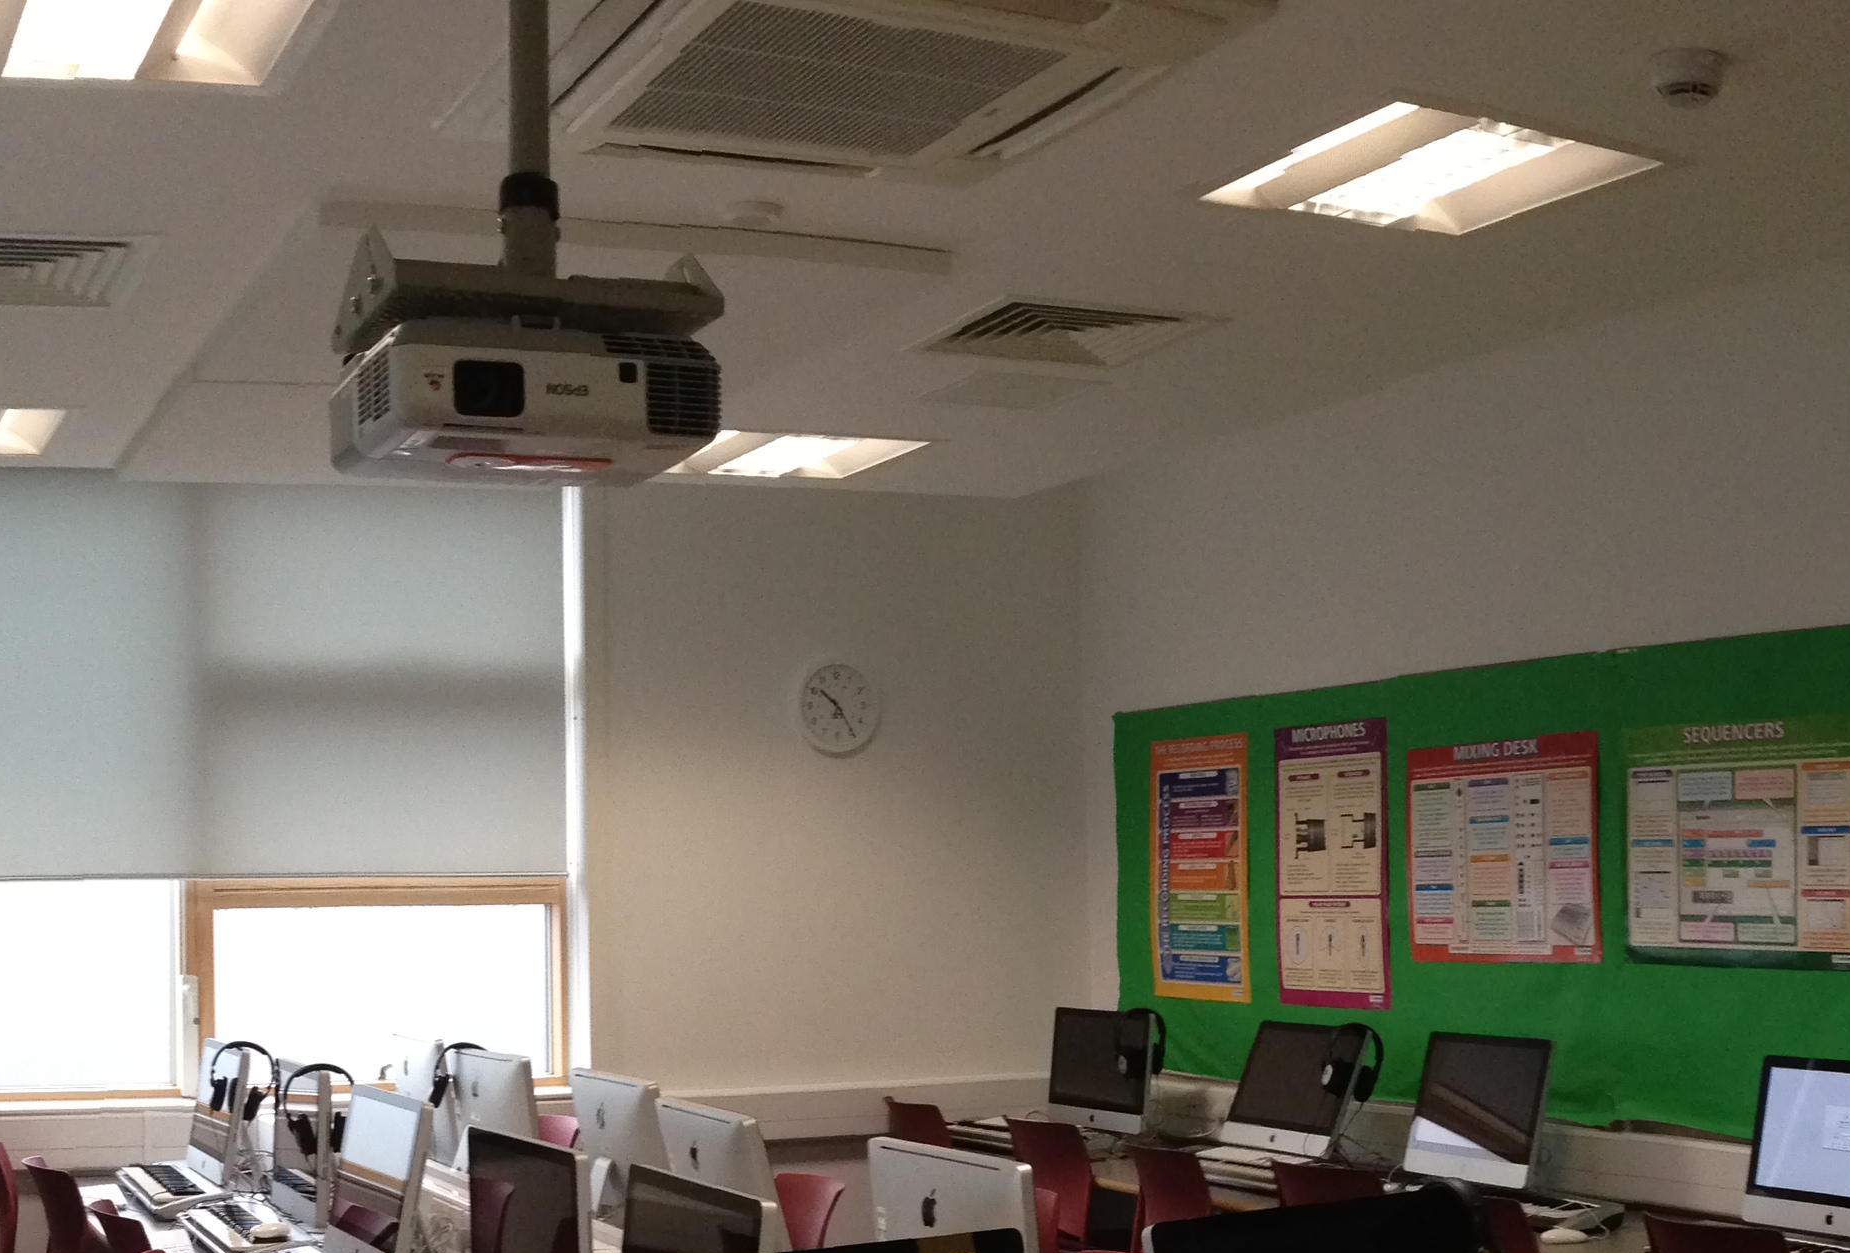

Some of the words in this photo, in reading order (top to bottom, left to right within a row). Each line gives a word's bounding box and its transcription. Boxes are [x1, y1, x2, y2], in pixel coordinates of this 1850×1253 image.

[545, 383, 589, 396] EPSON
[1291, 722, 1366, 744] MICROPHONES
[1682, 721, 1785, 745] SEQUENCERS
[1453, 742, 1500, 761] MIXING
[1503, 738, 1539, 756] DESK
